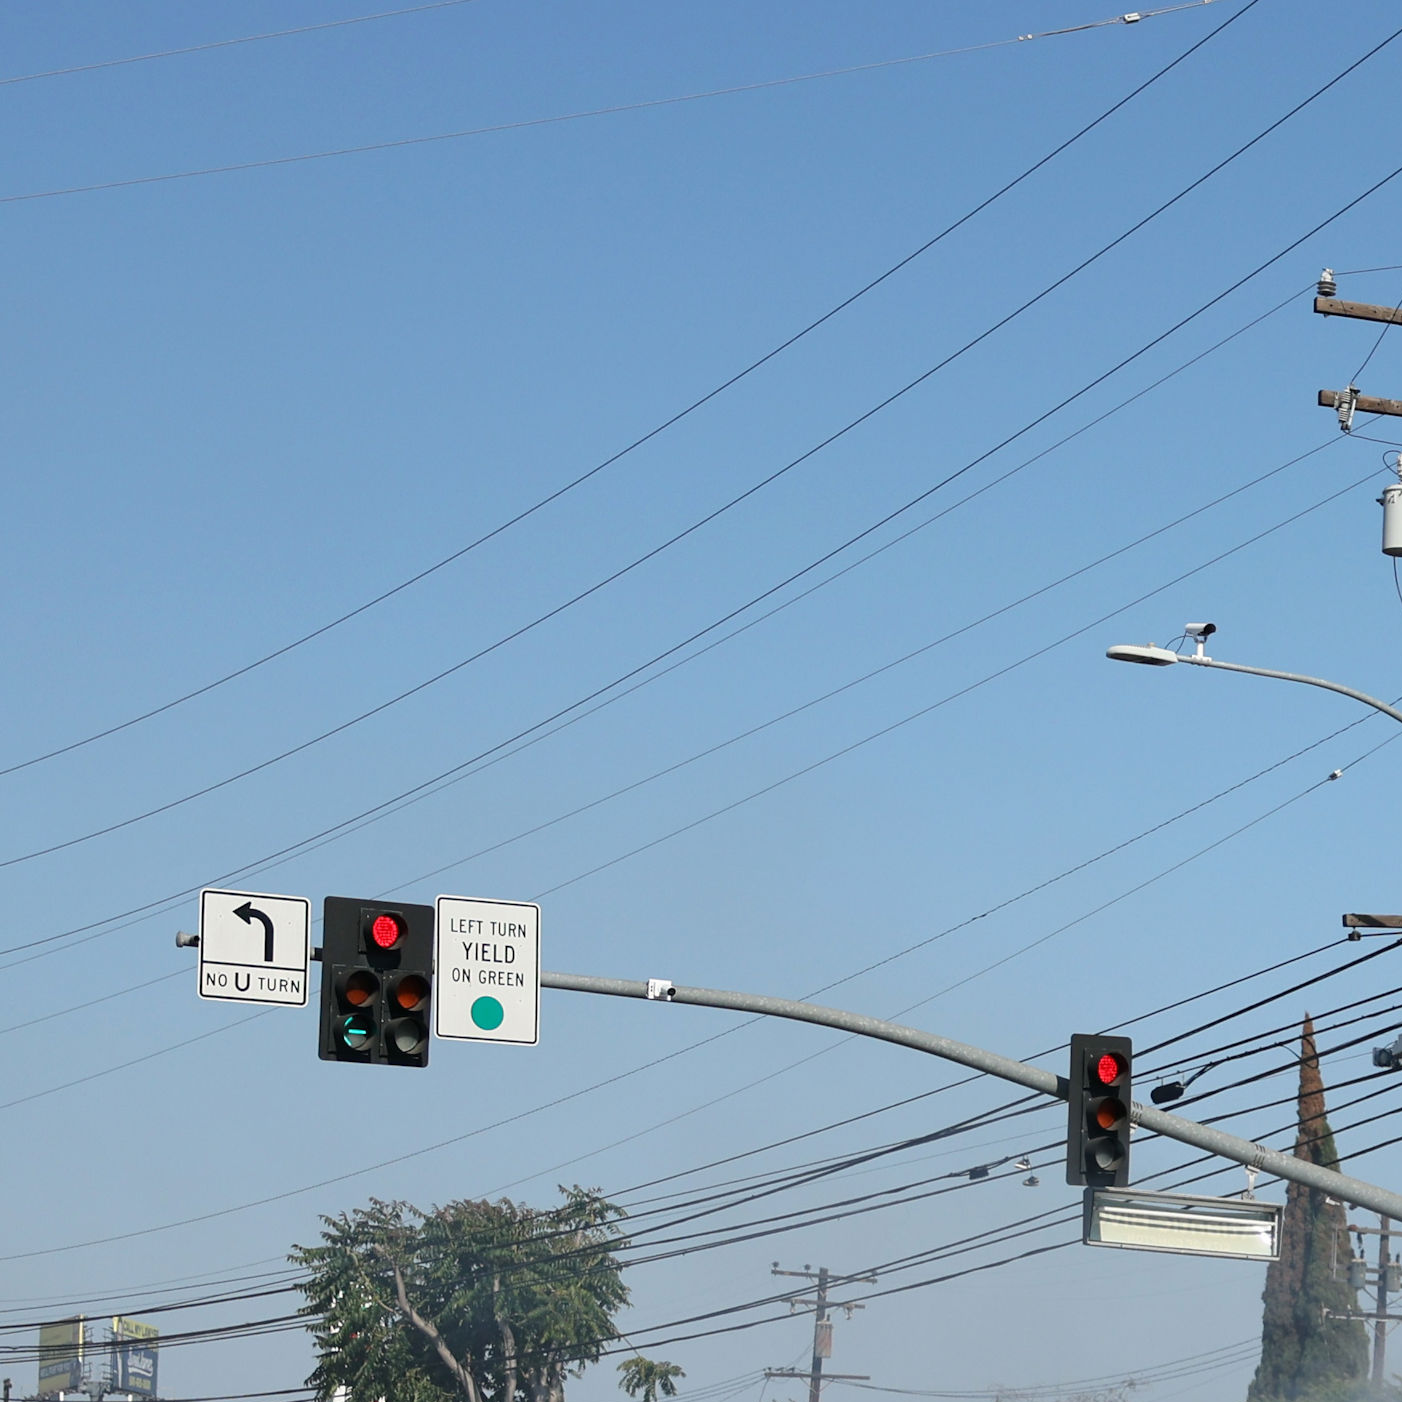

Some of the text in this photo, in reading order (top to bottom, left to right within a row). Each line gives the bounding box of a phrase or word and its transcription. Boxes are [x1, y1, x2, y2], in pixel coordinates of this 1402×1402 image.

[450, 918, 527, 938] LEFT TURN
[462, 942, 516, 965] YIELD
[206, 972, 301, 994] NO U TURN
[451, 967, 525, 987] ON GREEN
